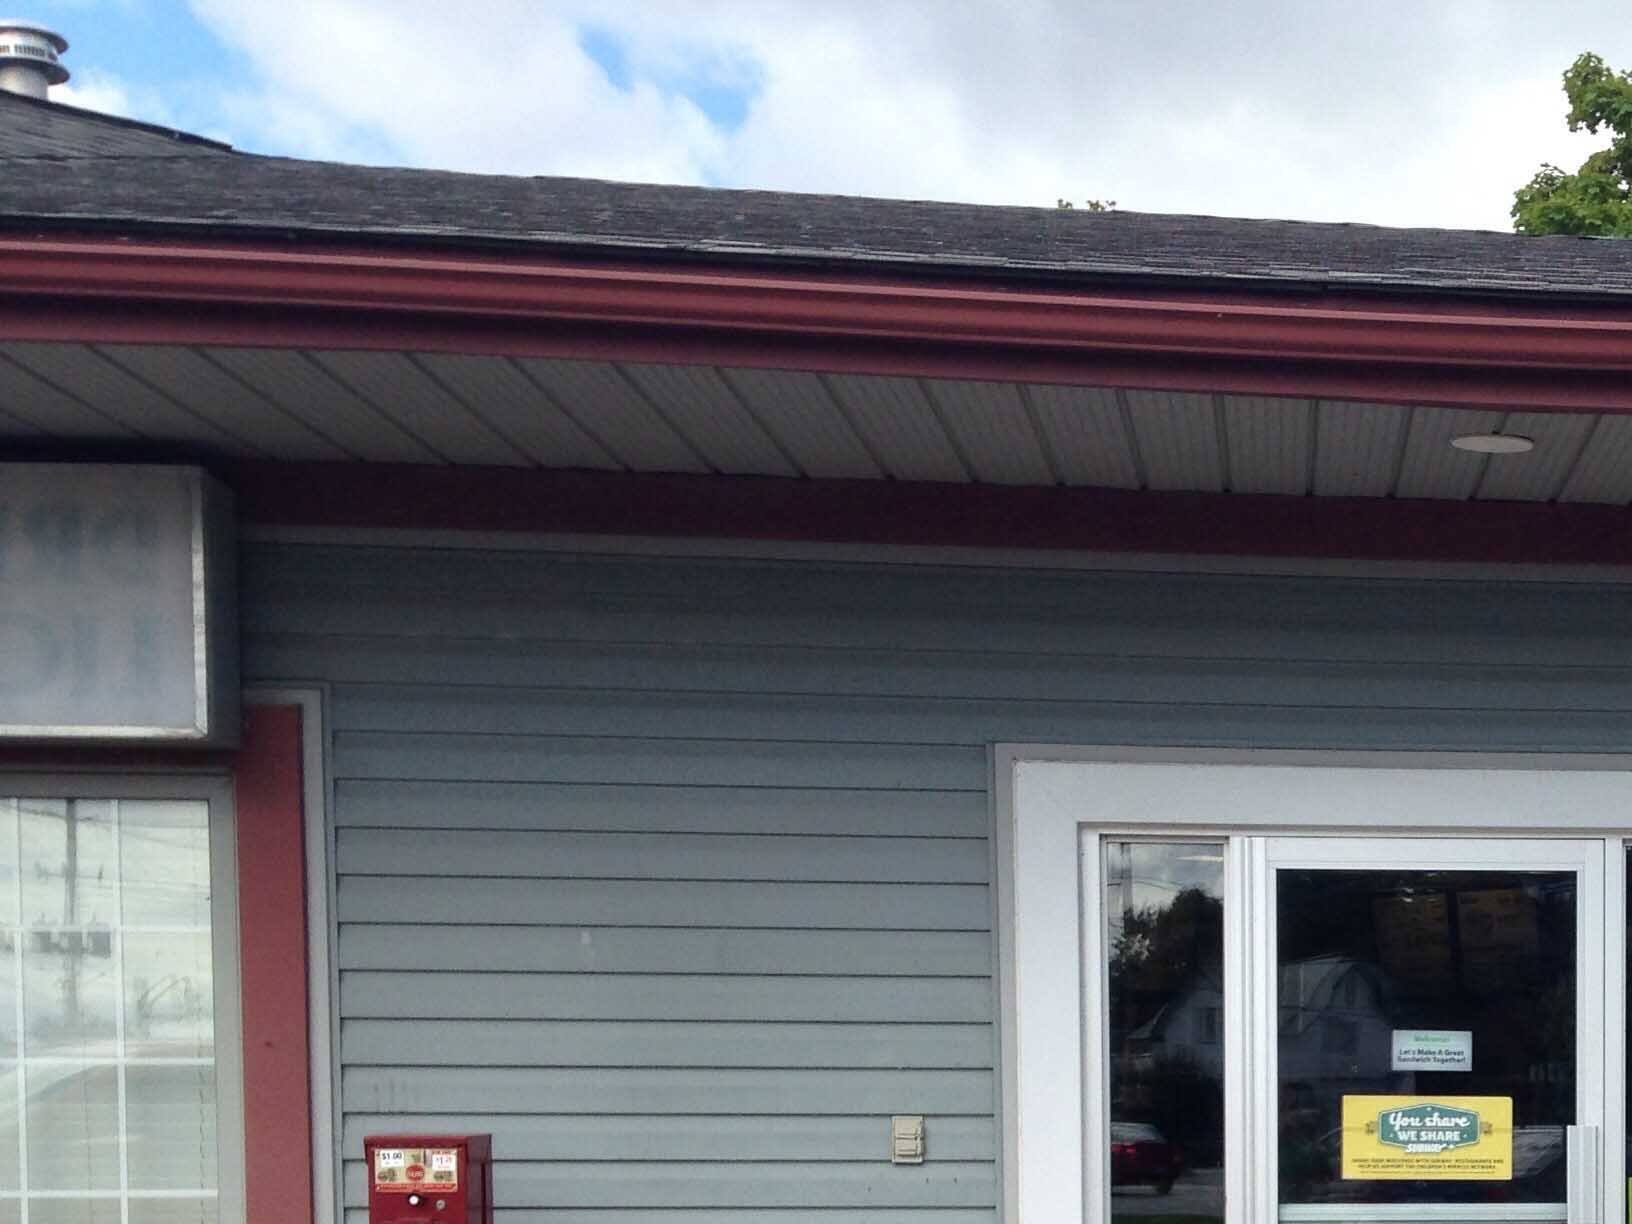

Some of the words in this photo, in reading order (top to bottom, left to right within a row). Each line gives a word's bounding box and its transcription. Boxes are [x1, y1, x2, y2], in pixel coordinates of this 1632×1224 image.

[1389, 1112, 1423, 1131] You
[1423, 1112, 1471, 1127] share
[1397, 1131, 1418, 1141] WE
[1419, 1131, 1461, 1141] SHARE
